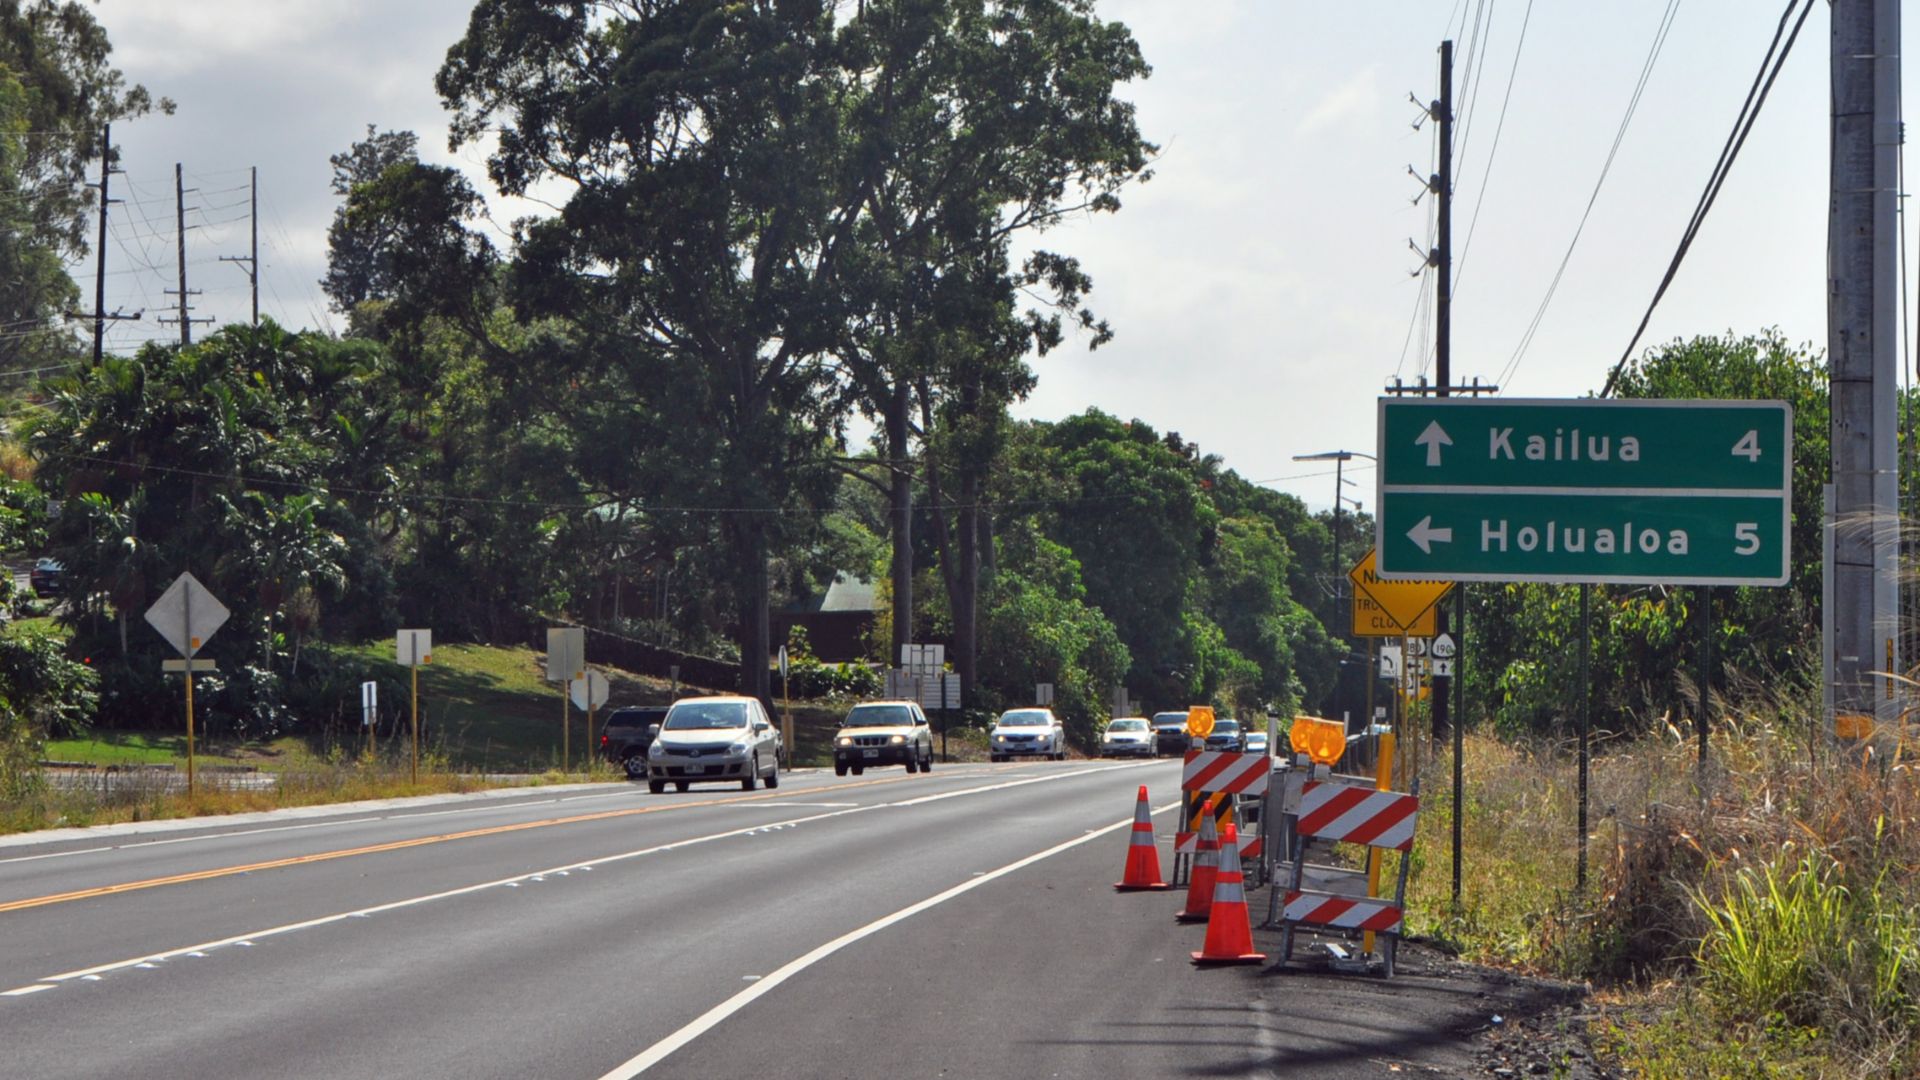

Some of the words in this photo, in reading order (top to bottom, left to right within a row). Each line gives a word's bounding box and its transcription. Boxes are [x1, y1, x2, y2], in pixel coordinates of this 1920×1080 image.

[1489, 428, 1640, 462] Kailua
[1730, 430, 1762, 462] 4
[1481, 519, 1688, 555] Holualoa
[1734, 522, 1761, 556] 5
